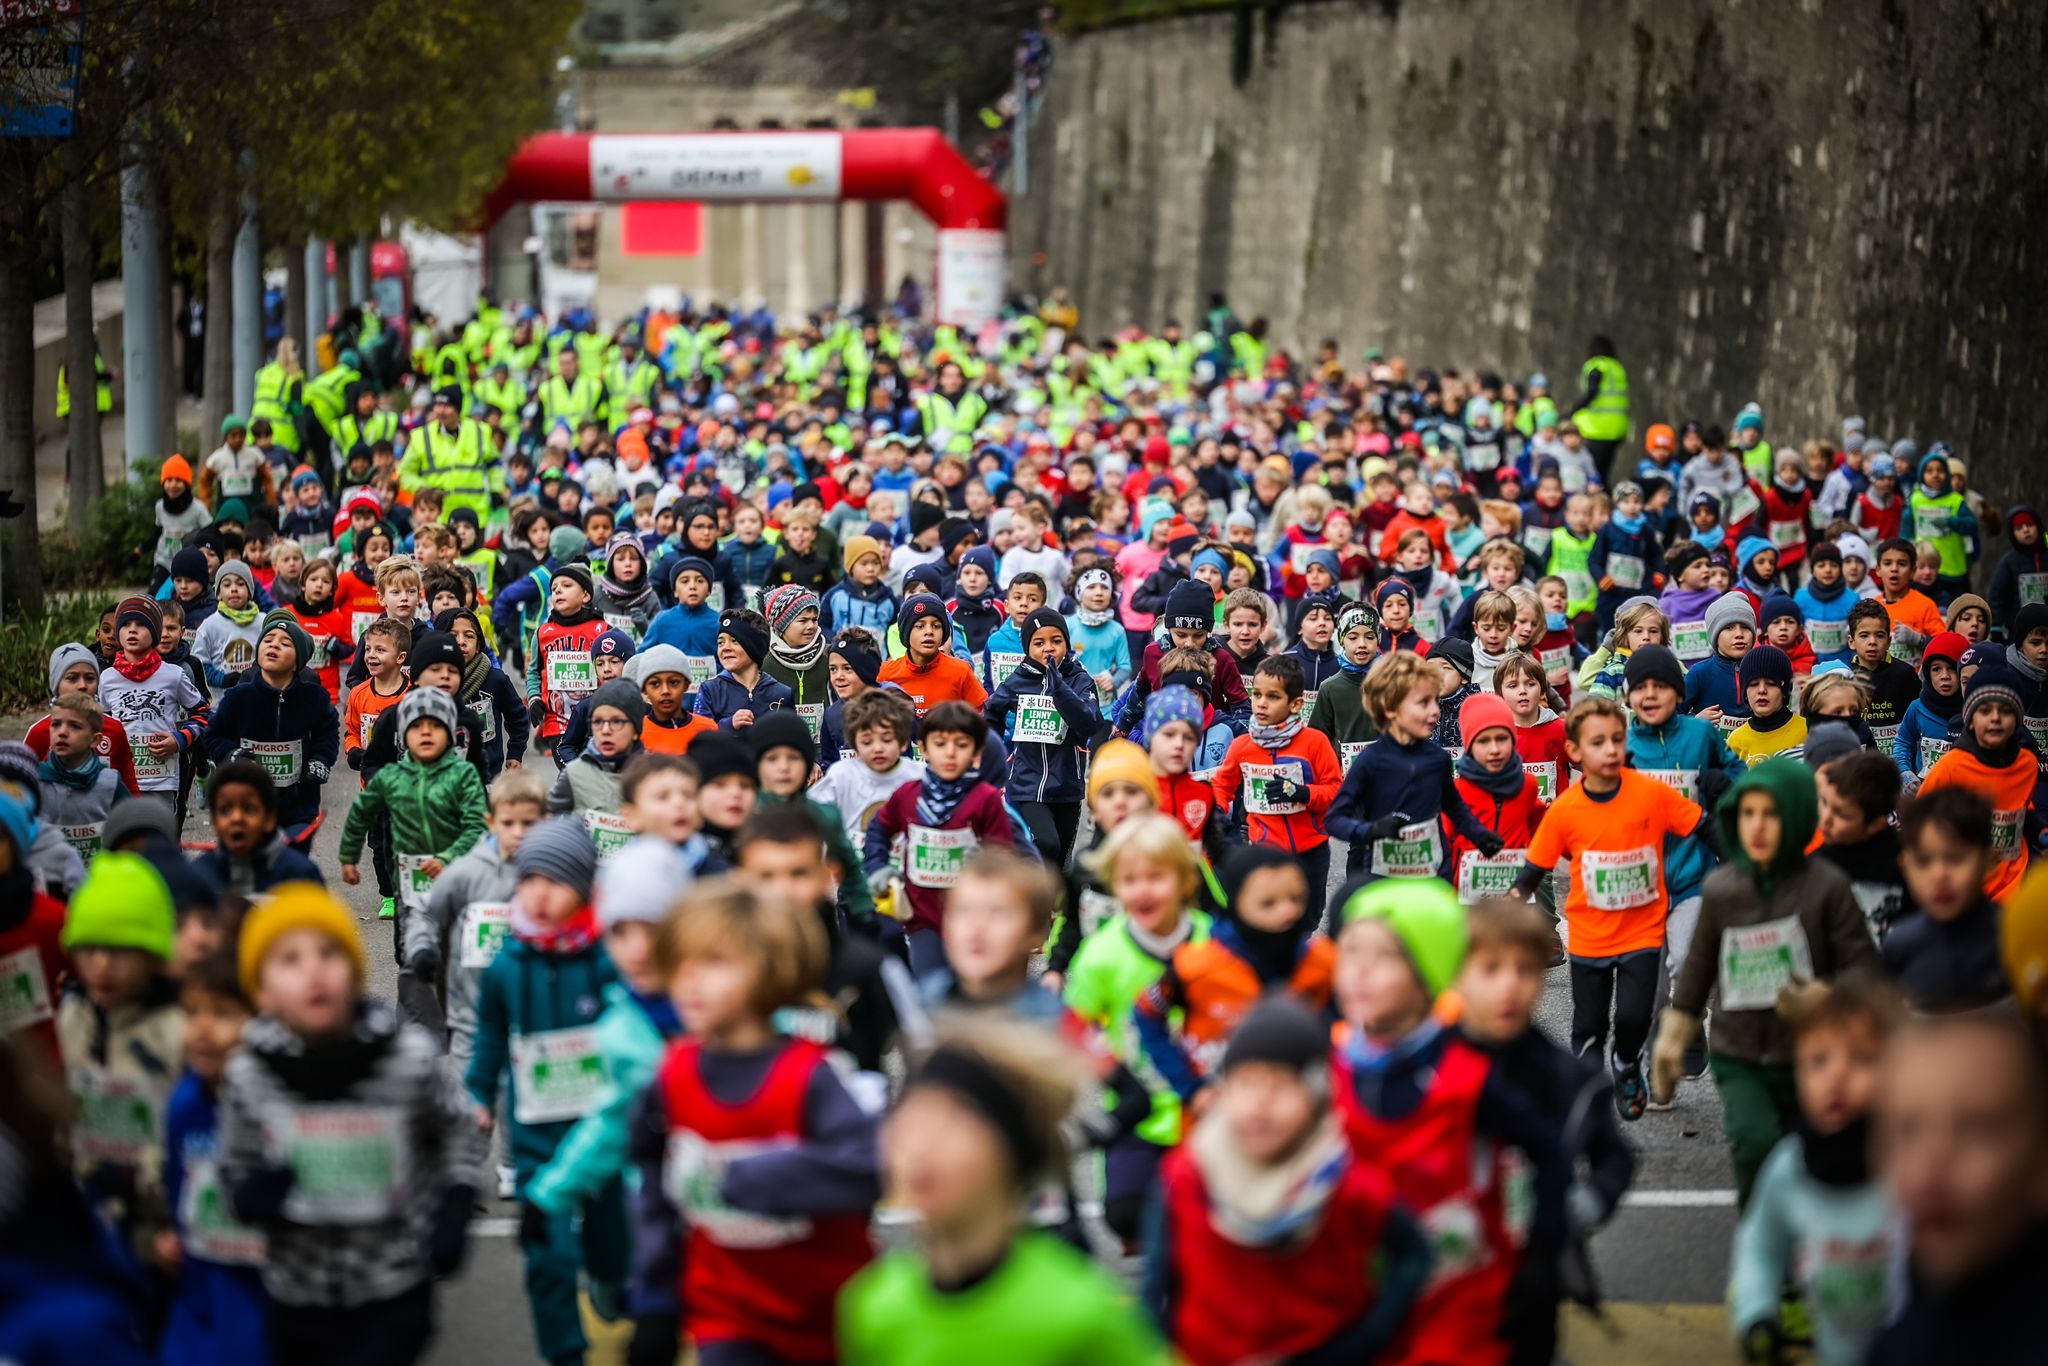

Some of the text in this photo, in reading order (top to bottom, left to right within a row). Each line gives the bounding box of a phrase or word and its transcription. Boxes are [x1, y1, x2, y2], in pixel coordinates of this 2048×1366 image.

[1174, 616, 1203, 629] NYC
[556, 653, 588, 661] MIGROS
[565, 663, 579, 672] LEO
[557, 671, 588, 681] 14673
[568, 681, 586, 689] UBS
[1029, 710, 1053, 720] LENNY
[1023, 719, 1057, 731] 54168
[1880, 727, 1898, 738] UBS
[252, 743, 291, 753] MIGROS
[261, 756, 281, 764] LIAM
[1251, 767, 1288, 777] MIGROS
[73, 826, 96, 838] UBS
[1394, 843, 1421, 853] LOUIS
[1599, 851, 1645, 865] MIGROS
[1388, 867, 1430, 876] MIGROS
[1620, 892, 1646, 904] UBS
